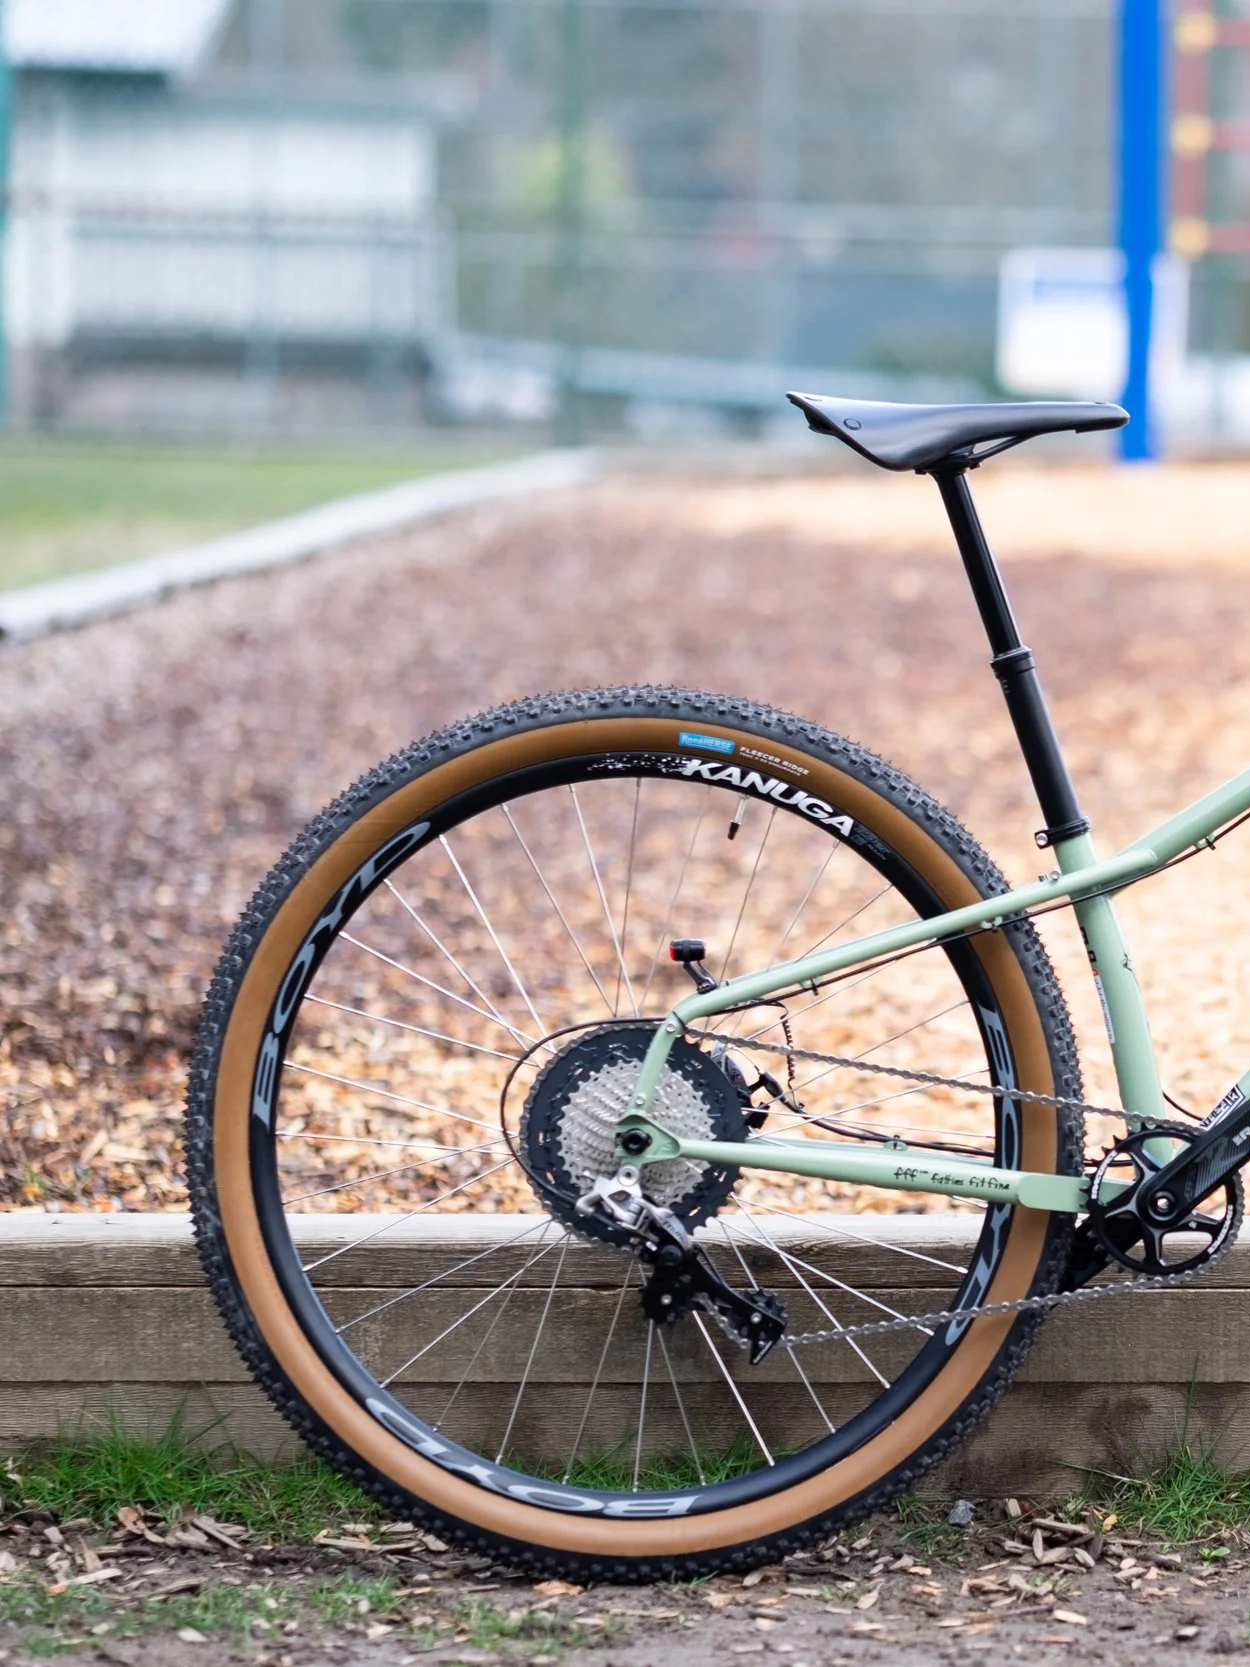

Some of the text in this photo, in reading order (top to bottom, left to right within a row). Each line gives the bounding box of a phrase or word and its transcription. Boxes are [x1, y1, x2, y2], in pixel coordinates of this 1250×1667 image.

[683, 759, 855, 837] KANUGA
[739, 745, 781, 763] FLEECER
[781, 759, 810, 776] RIDGE
[253, 820, 431, 1129] BOYD
[930, 1173, 964, 1186] fatties
[969, 1176, 986, 1188] fit
[987, 1177, 1010, 1190] fine
[365, 1398, 702, 1517] BOYD
